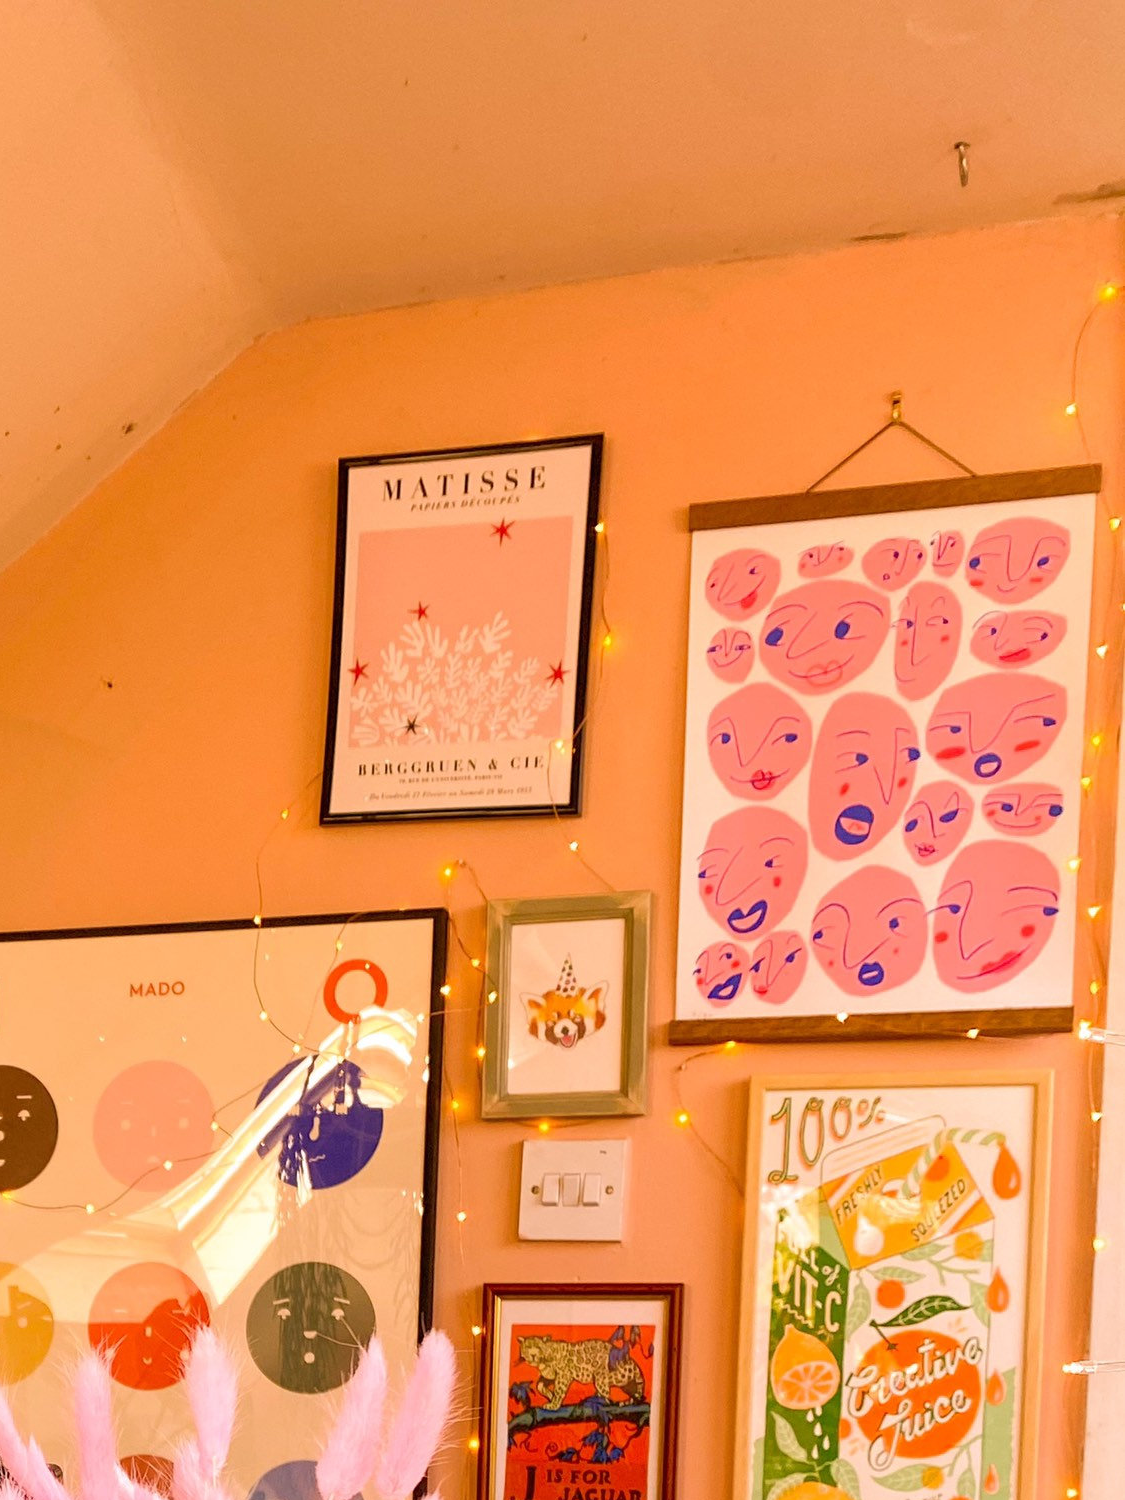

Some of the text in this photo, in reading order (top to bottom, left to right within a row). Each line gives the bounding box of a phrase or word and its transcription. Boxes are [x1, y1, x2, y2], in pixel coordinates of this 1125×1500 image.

[383, 466, 546, 501] MATISSE
[359, 755, 545, 776] BERGGRUEN & CIE
[129, 981, 186, 998] MADO
[767, 1096, 886, 1185] 100%
[834, 1165, 884, 1226] FRESHLY
[845, 1335, 983, 1418] Creative
[868, 1389, 973, 1472] Juice
[546, 1469, 612, 1484] IS FOR
